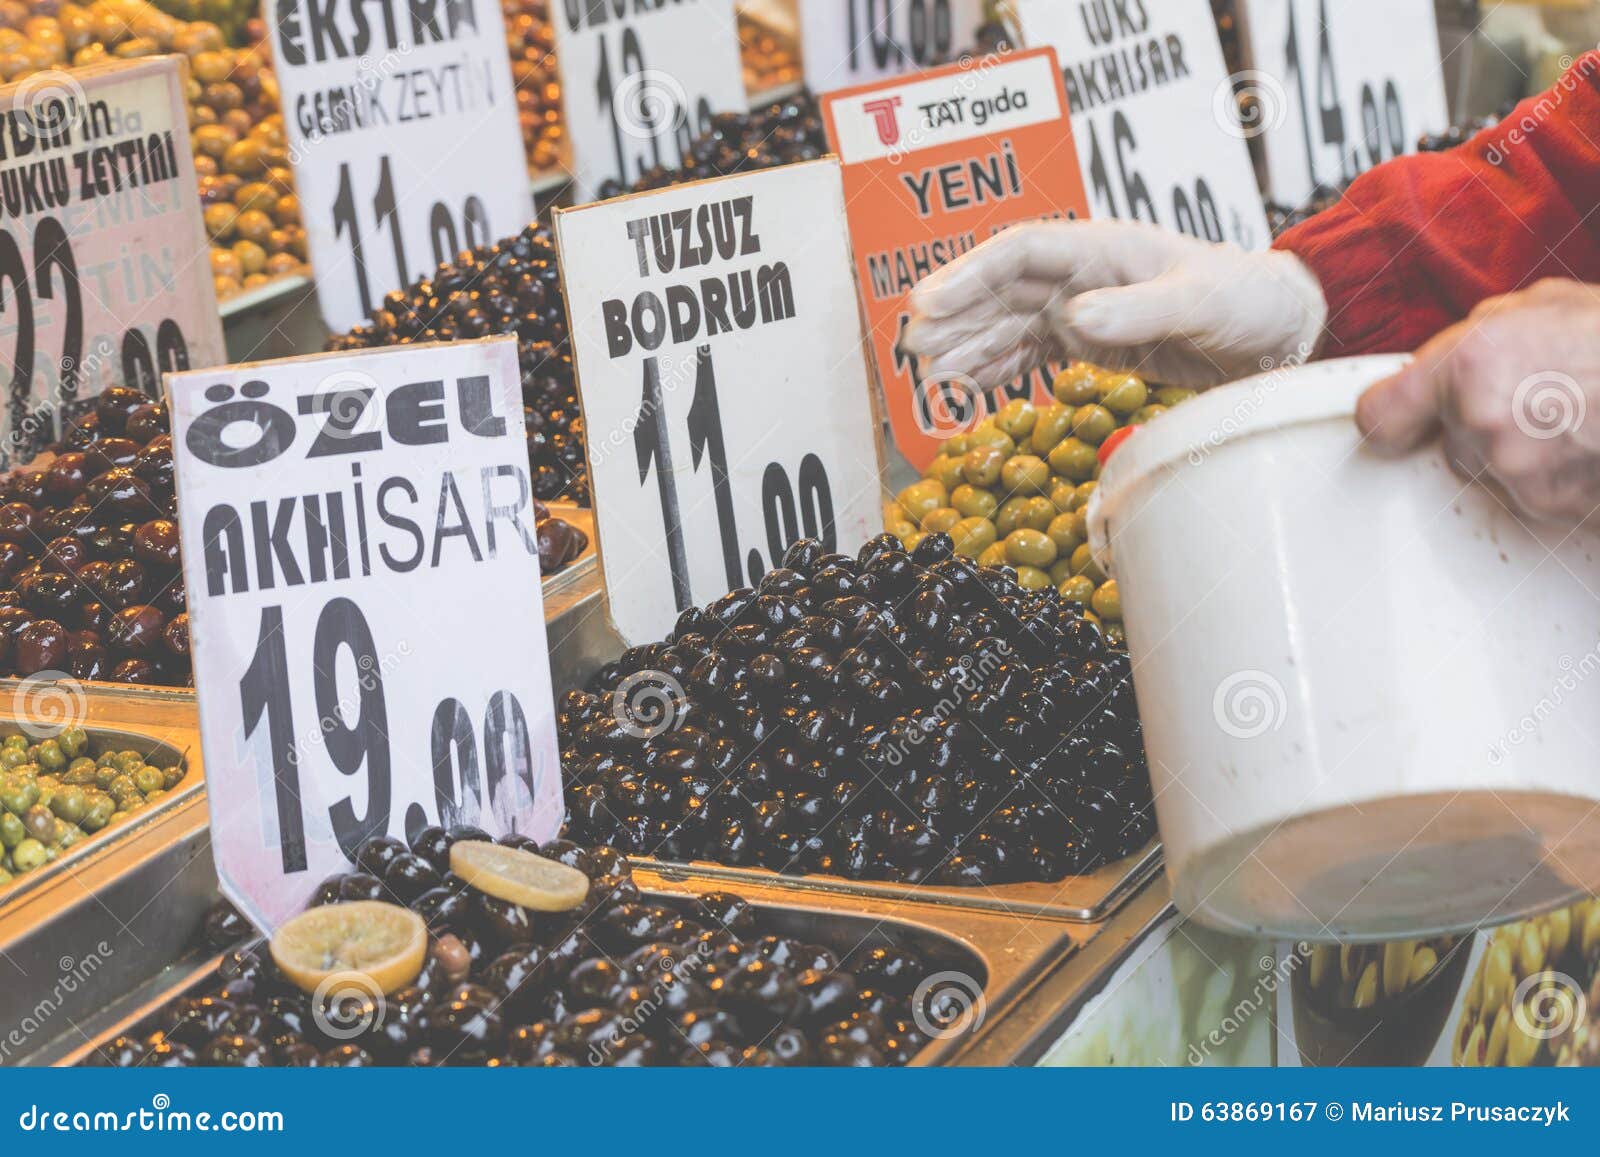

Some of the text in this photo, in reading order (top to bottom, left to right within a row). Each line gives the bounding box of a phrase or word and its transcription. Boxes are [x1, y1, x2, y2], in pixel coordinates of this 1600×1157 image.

[277, 0, 481, 66] EKSTRA
[0, 157, 71, 219] UKLU
[902, 140, 1021, 216] YENİ
[1090, 110, 1225, 243] 1600
[332, 154, 491, 320] 1100
[626, 195, 761, 278] TUZSUZ
[602, 260, 796, 360] BODRUM
[185, 375, 508, 469] ÖZEL
[633, 342, 838, 614] 11.00
[202, 461, 538, 598] AKHİSAR
[239, 596, 536, 876] 19.00
